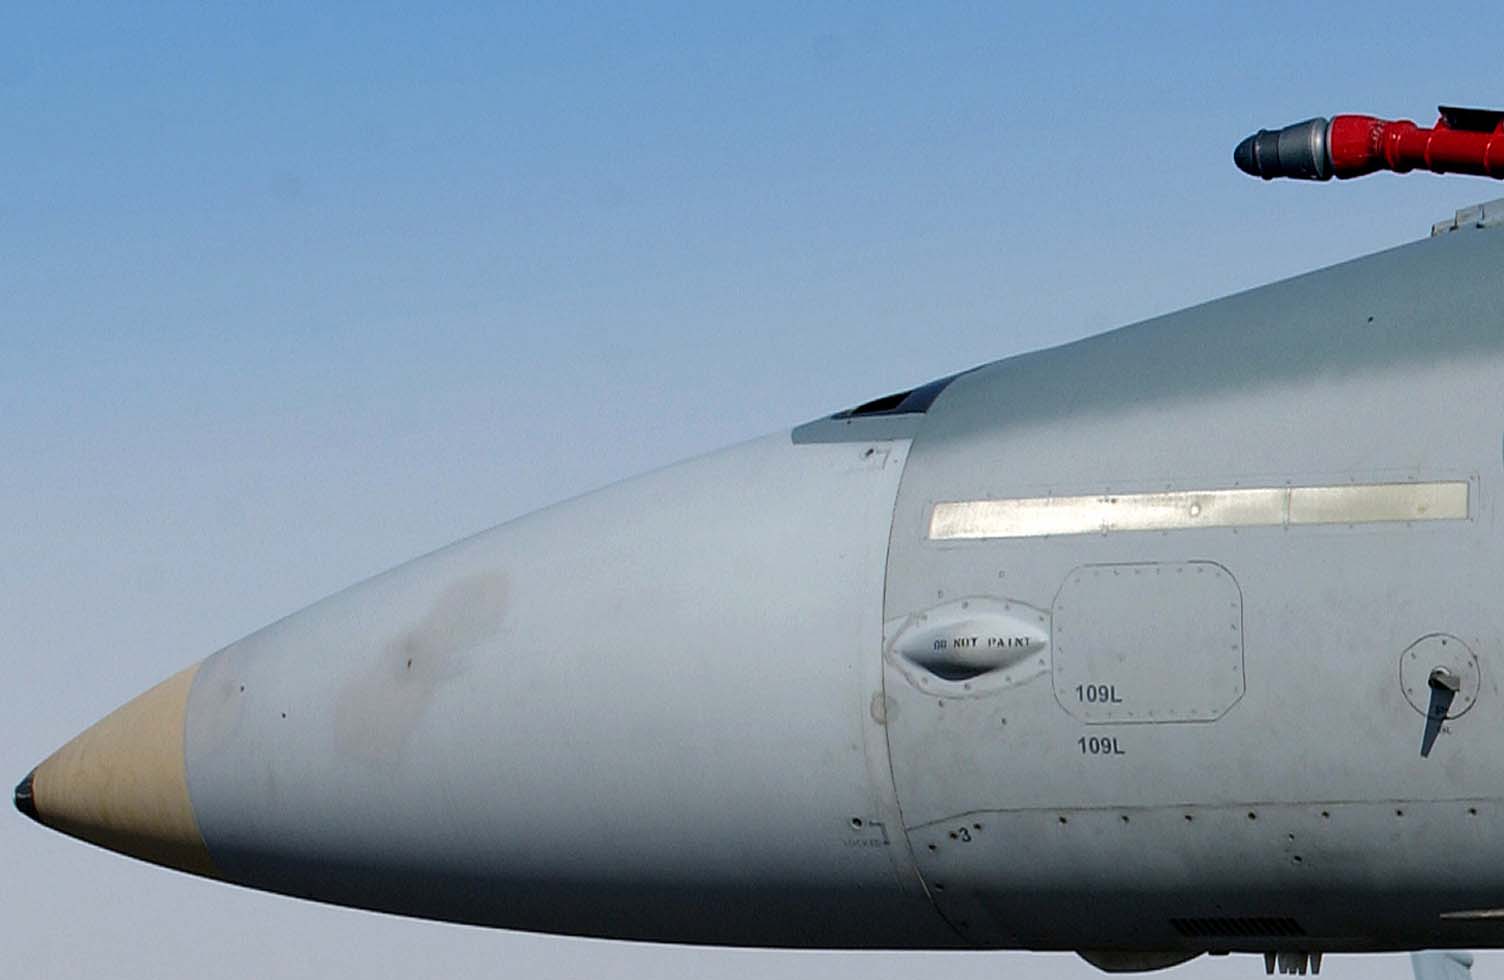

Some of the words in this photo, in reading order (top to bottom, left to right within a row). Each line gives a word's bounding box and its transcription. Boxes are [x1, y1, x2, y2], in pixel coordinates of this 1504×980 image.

[953, 636, 979, 648] NOT
[987, 635, 1031, 648] PAINT
[1075, 683, 1123, 704] 109L
[1077, 736, 1126, 755] 109L
[959, 827, 972, 842] 3
